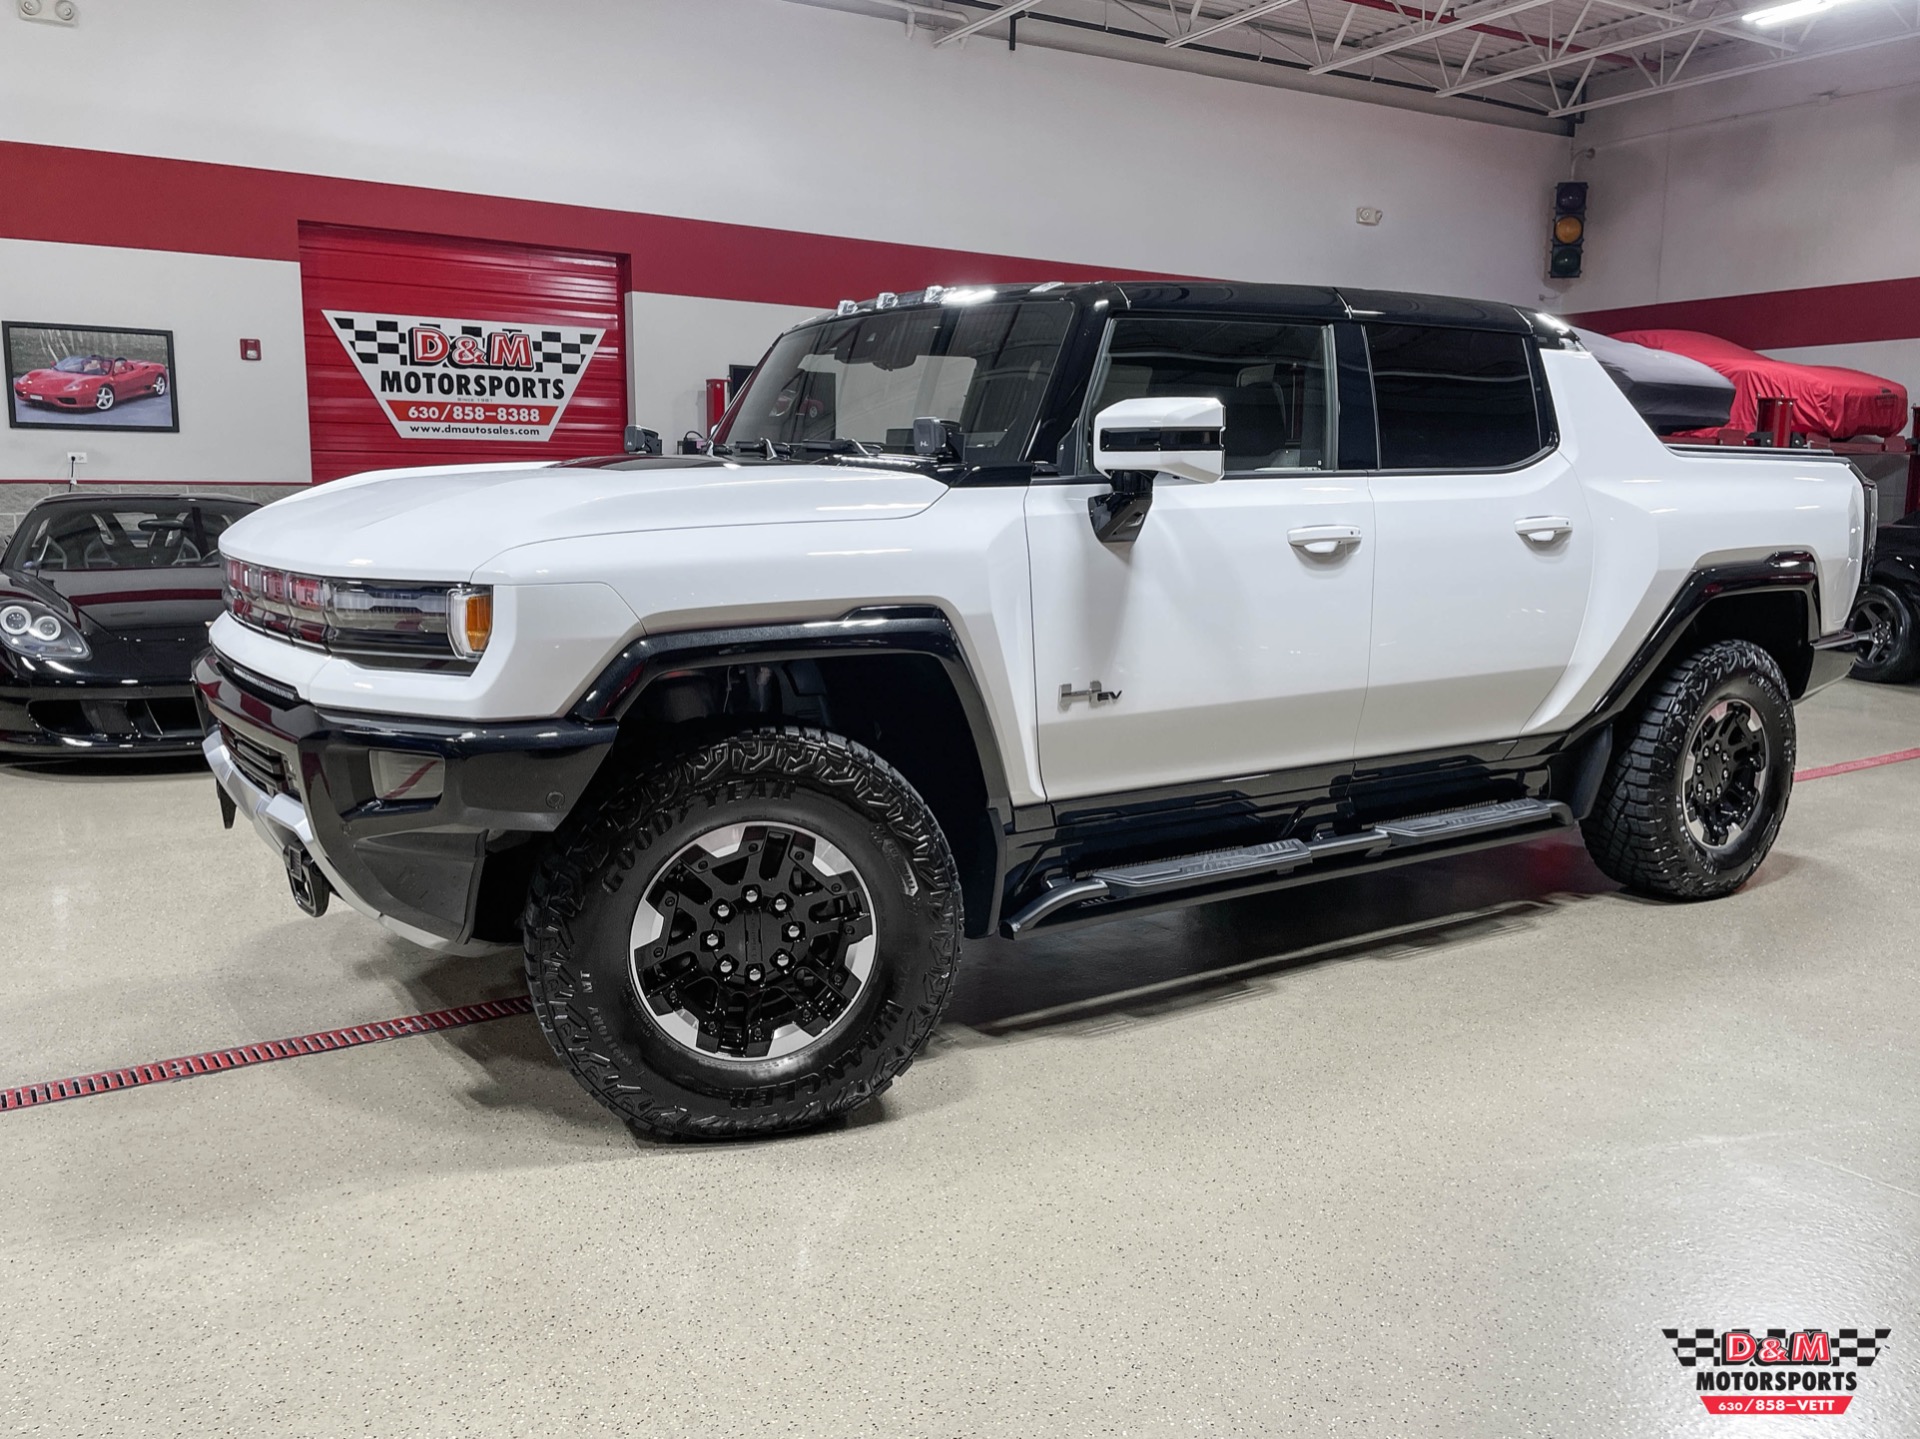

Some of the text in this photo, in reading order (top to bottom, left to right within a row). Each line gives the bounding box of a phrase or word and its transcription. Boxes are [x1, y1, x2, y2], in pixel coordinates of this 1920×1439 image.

[410, 326, 534, 371] D&M
[380, 370, 565, 400] MOTORSPORTS
[408, 404, 540, 423] 630/858-8388
[410, 424, 540, 436] www.dmautosales.com
